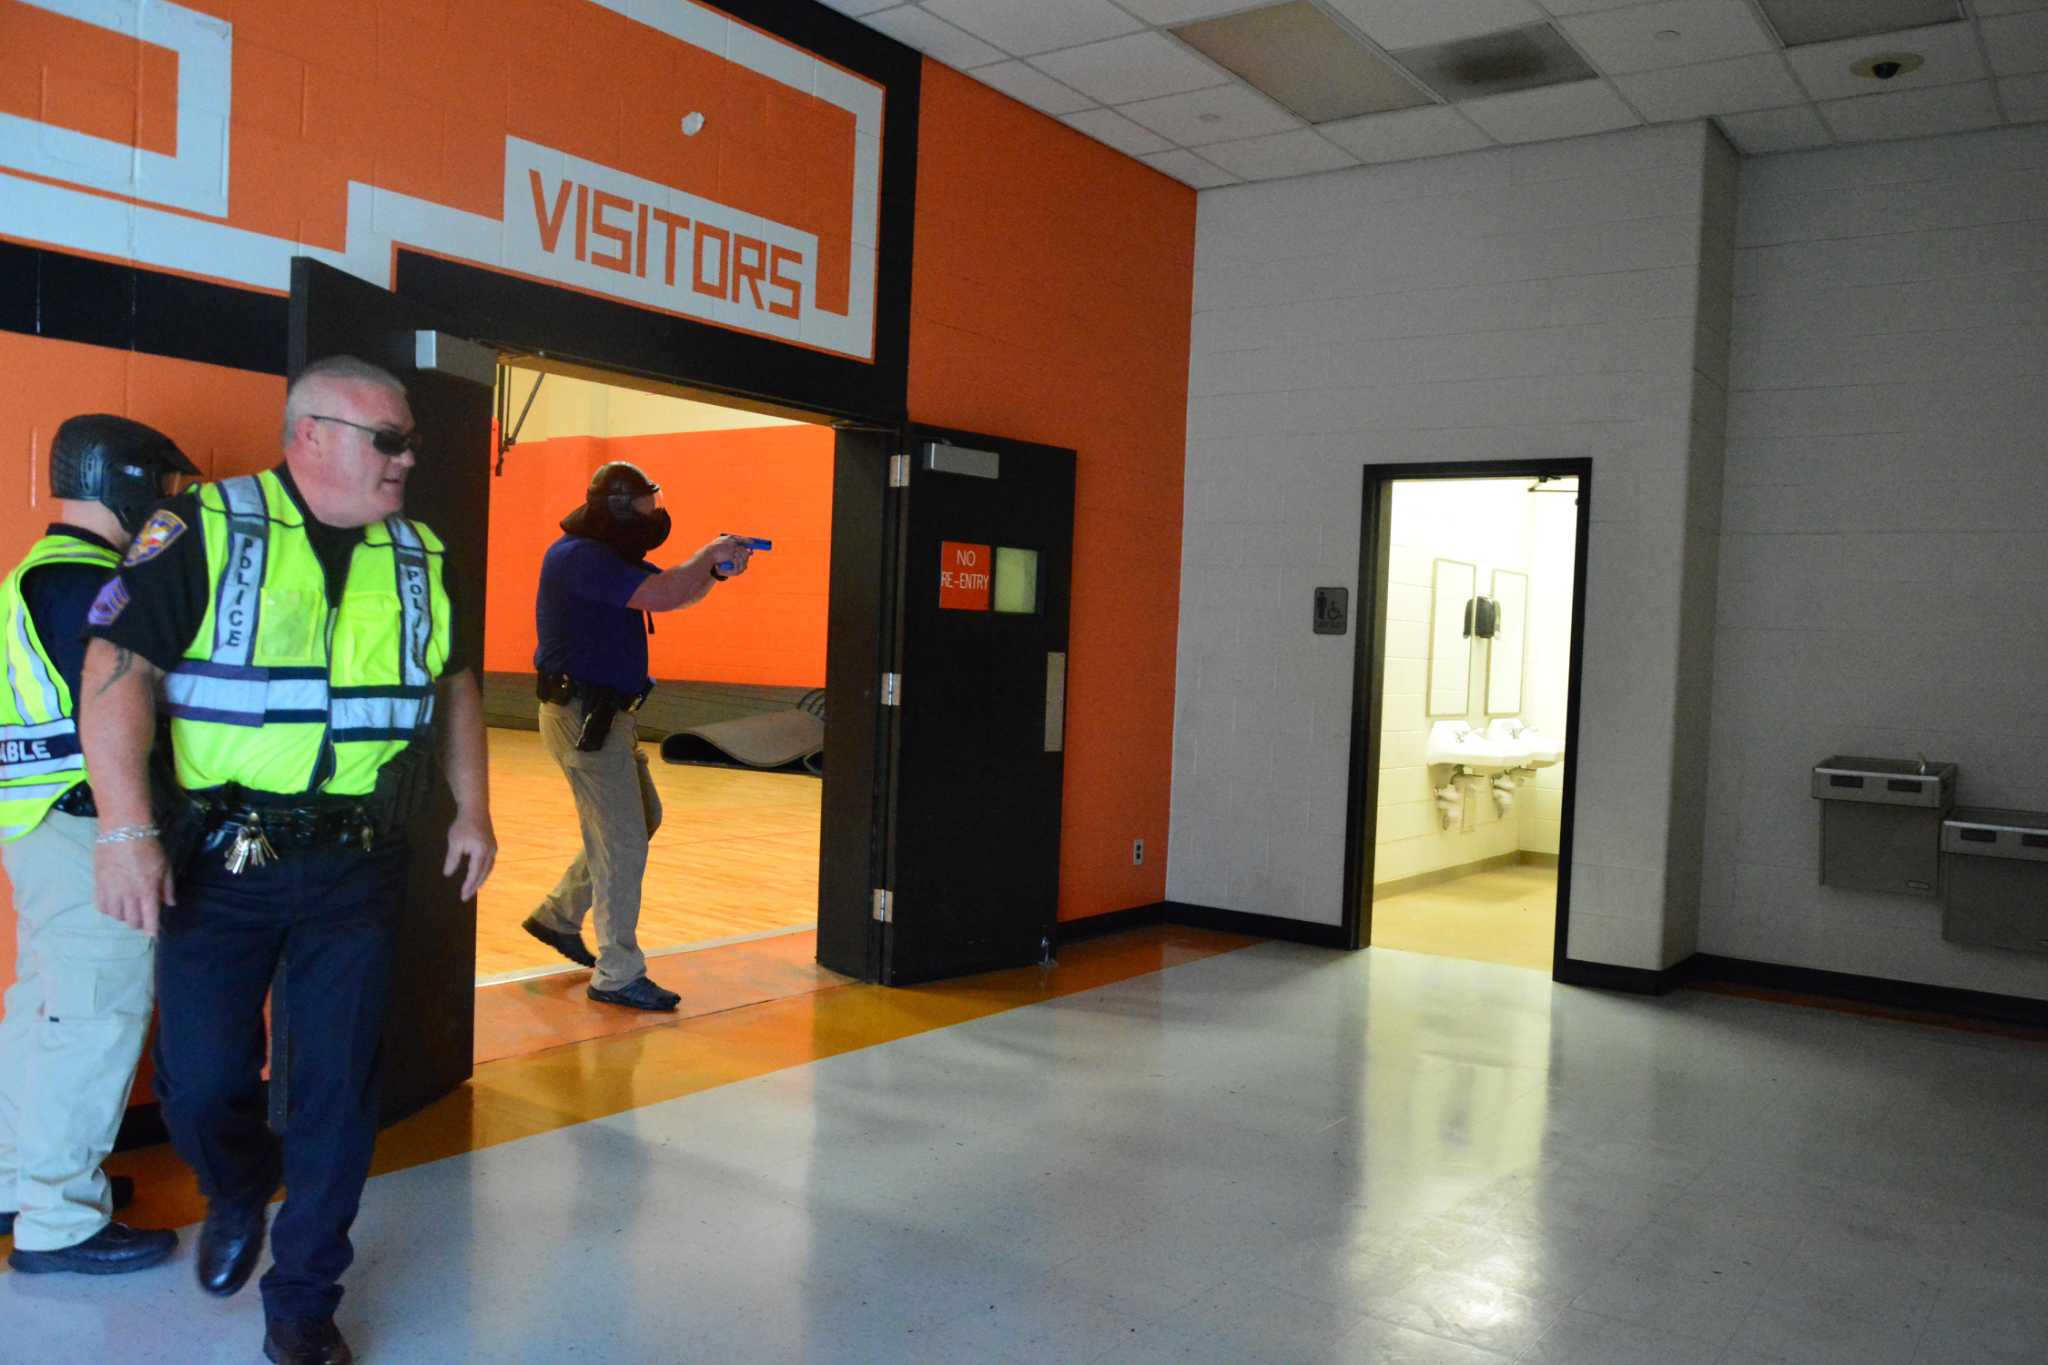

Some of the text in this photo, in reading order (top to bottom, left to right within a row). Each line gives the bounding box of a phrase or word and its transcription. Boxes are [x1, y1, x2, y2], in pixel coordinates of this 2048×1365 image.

[528, 168, 803, 320] VISITORS
[225, 537, 254, 647] POLICE
[941, 571, 989, 590] RE-ENTRY
[956, 550, 976, 566] NO
[407, 569, 425, 666] POLI
